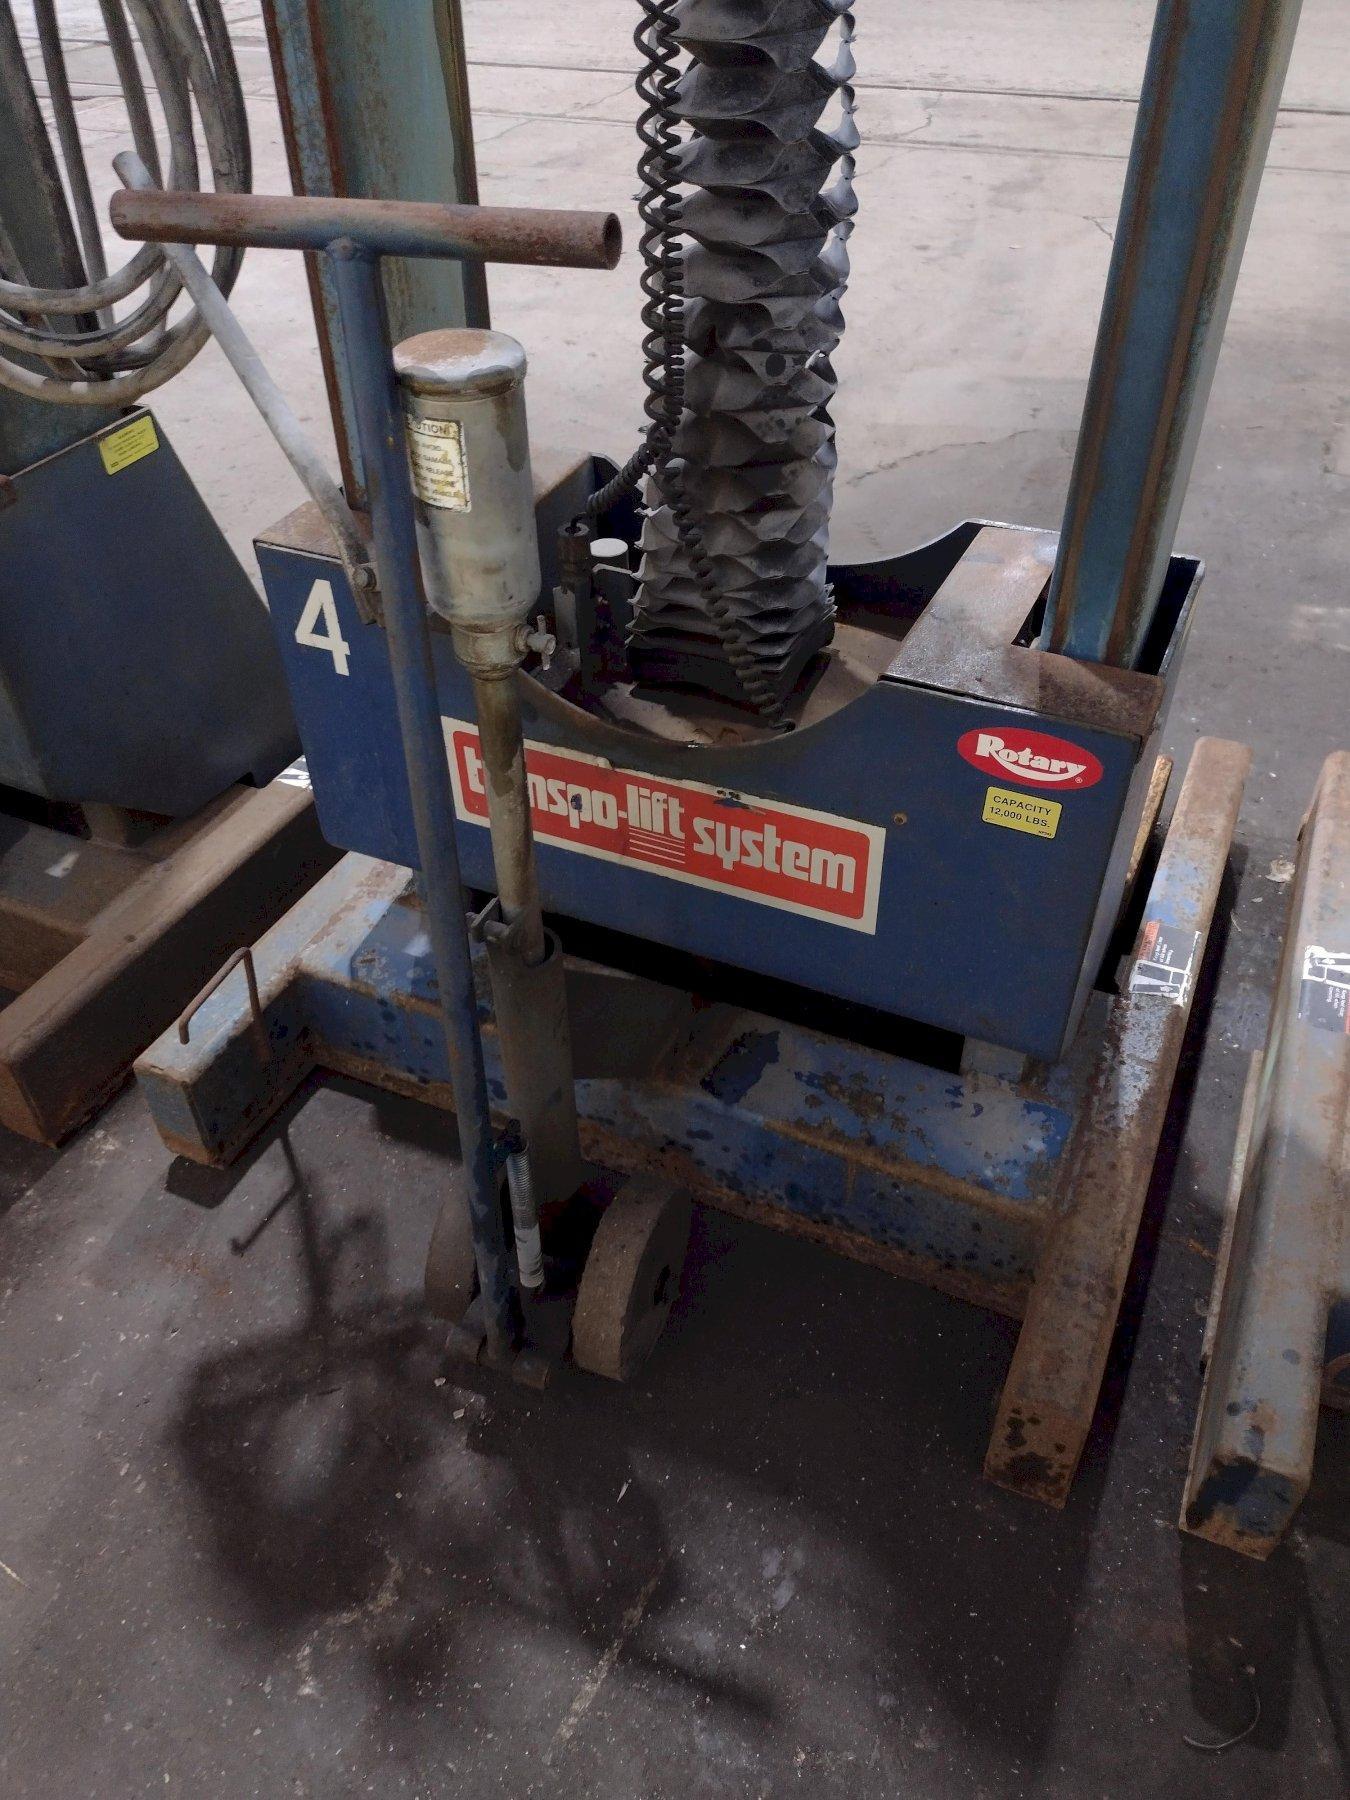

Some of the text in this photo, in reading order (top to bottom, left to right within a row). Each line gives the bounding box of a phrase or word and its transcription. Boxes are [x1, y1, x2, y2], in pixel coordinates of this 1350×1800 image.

[295, 579, 351, 676] 4
[975, 733, 1087, 781] Rotary
[463, 745, 857, 894] tnspo-lift system
[990, 806, 1051, 828] 12,000 LBS.
[993, 795, 1052, 816] CAPACITY
